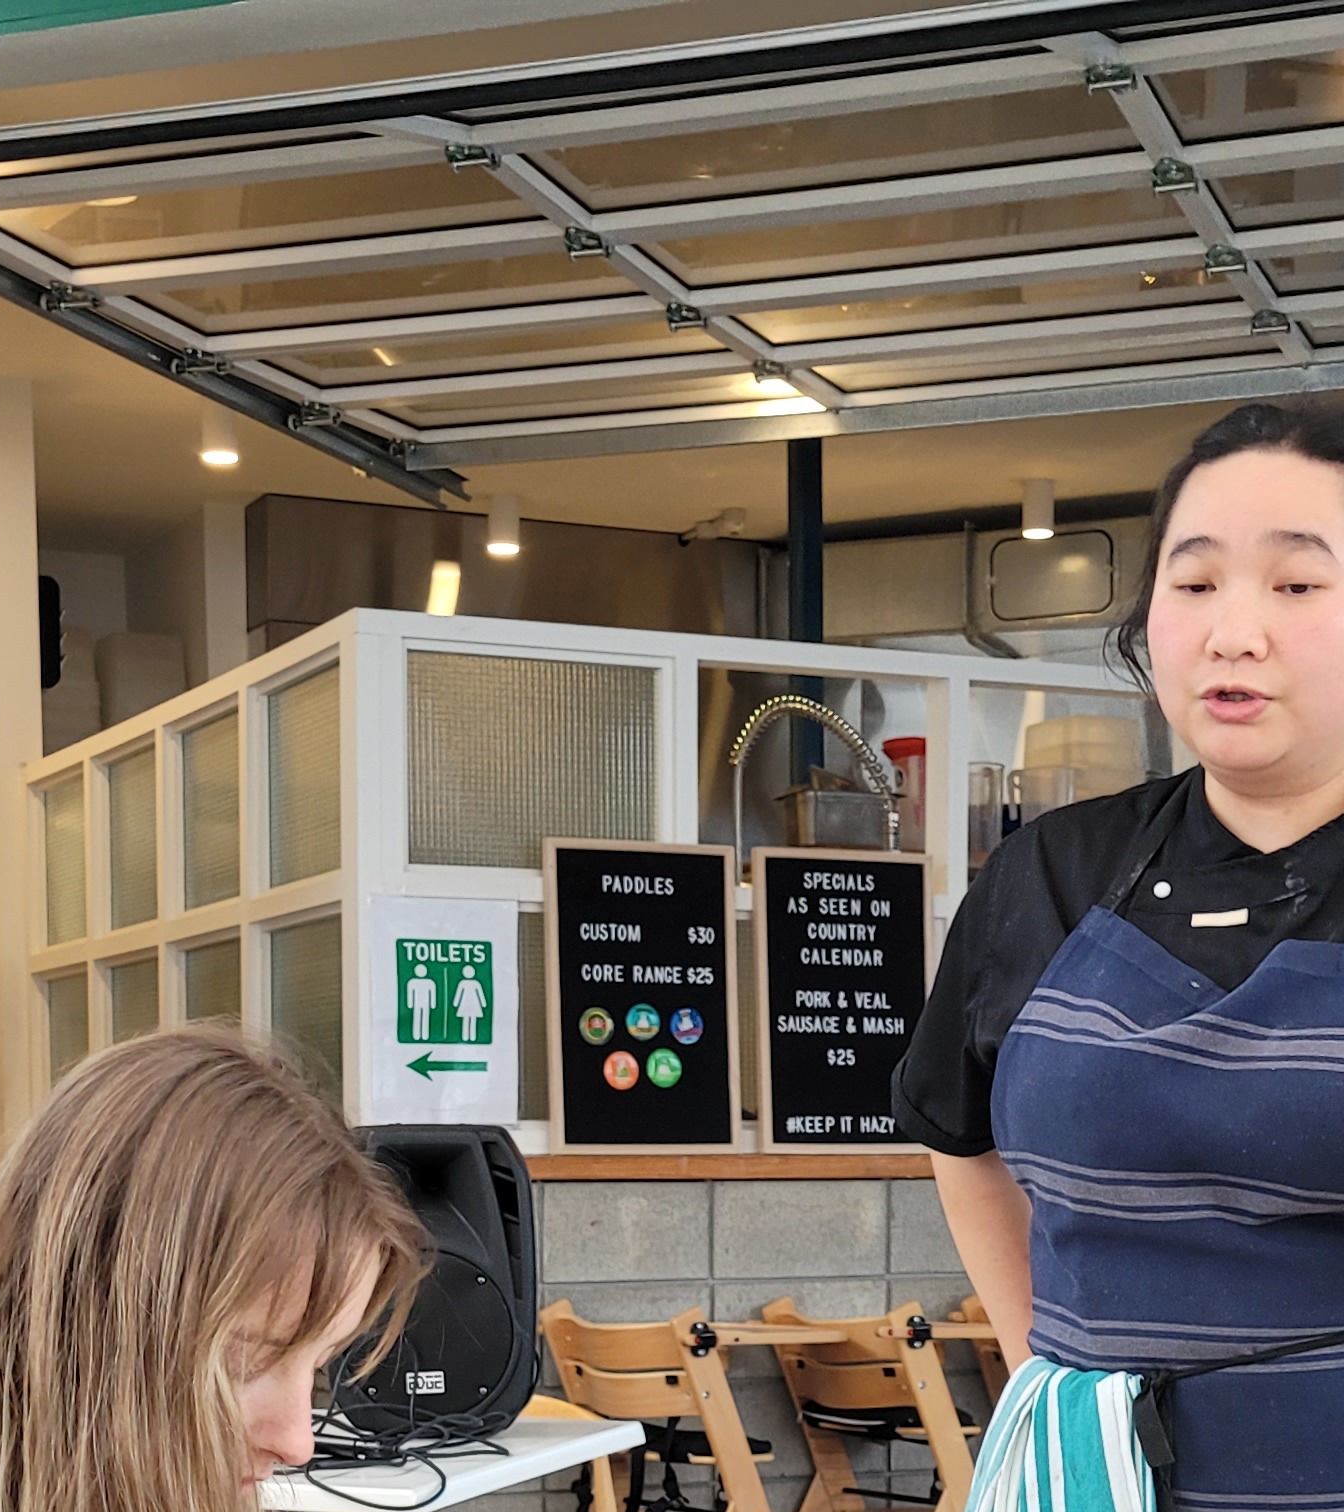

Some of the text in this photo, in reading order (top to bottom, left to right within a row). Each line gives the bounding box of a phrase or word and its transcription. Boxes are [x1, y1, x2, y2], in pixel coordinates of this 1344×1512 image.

[601, 874, 674, 895] PADDLES
[803, 871, 875, 892] SPECIALS
[786, 896, 891, 917] AS SEEN ON
[579, 923, 715, 944] CUSTOM $30
[807, 922, 877, 942] COUNTRY
[402, 942, 485, 963] TOILETS
[800, 947, 884, 967] CALENDAR
[581, 963, 714, 985] CORE RANGE $25
[795, 989, 892, 1010] PORK & VEAL
[777, 1014, 905, 1035] SAUSAGE & MASH
[826, 1048, 856, 1066] $25
[785, 1115, 896, 1135] #KEEP IT HAZY
